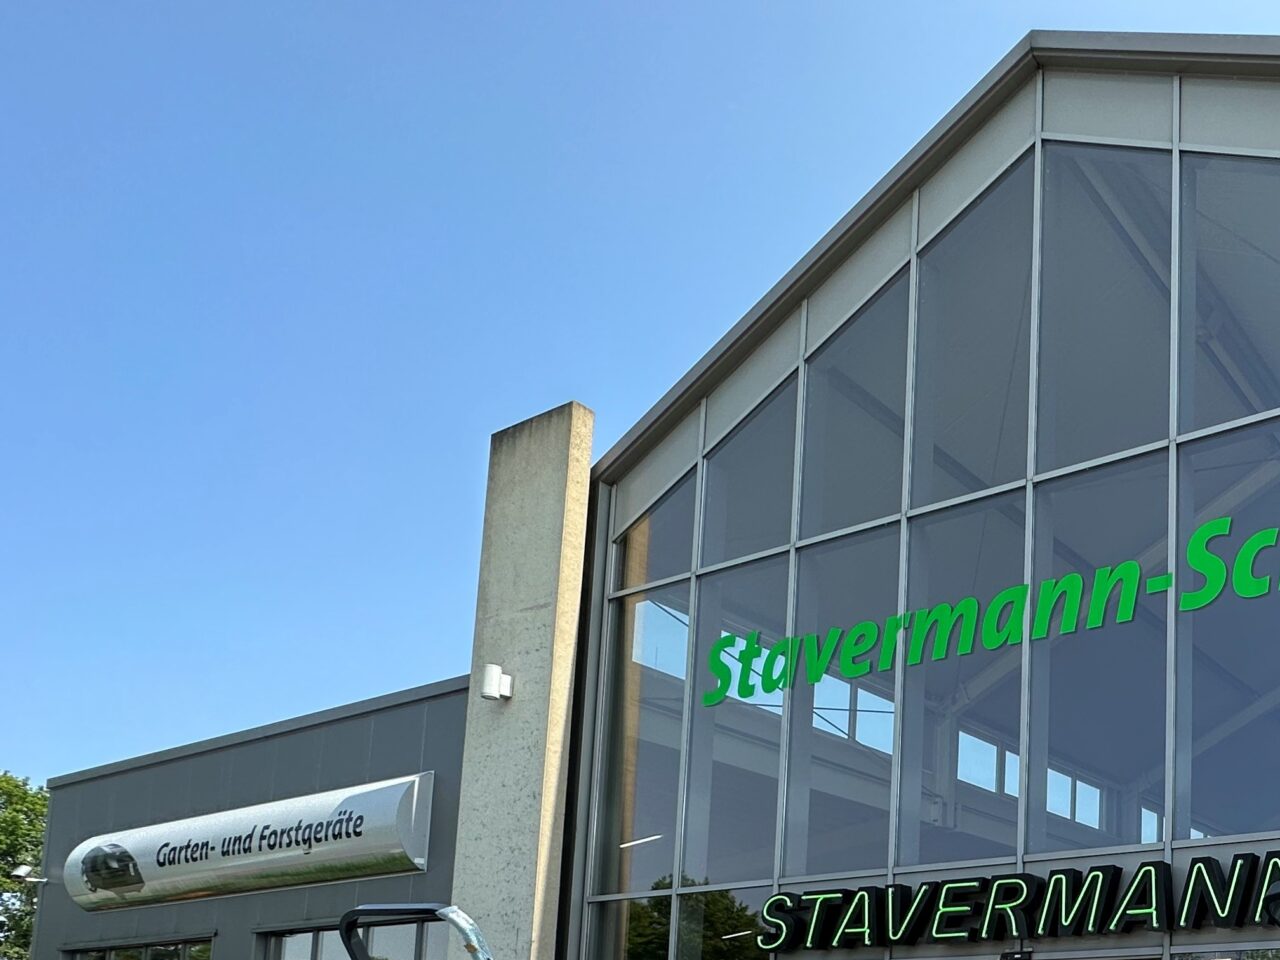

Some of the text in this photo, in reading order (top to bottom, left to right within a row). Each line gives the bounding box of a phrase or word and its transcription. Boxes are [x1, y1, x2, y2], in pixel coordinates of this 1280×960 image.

[156, 809, 365, 867] Garten- und Forstgeräte
